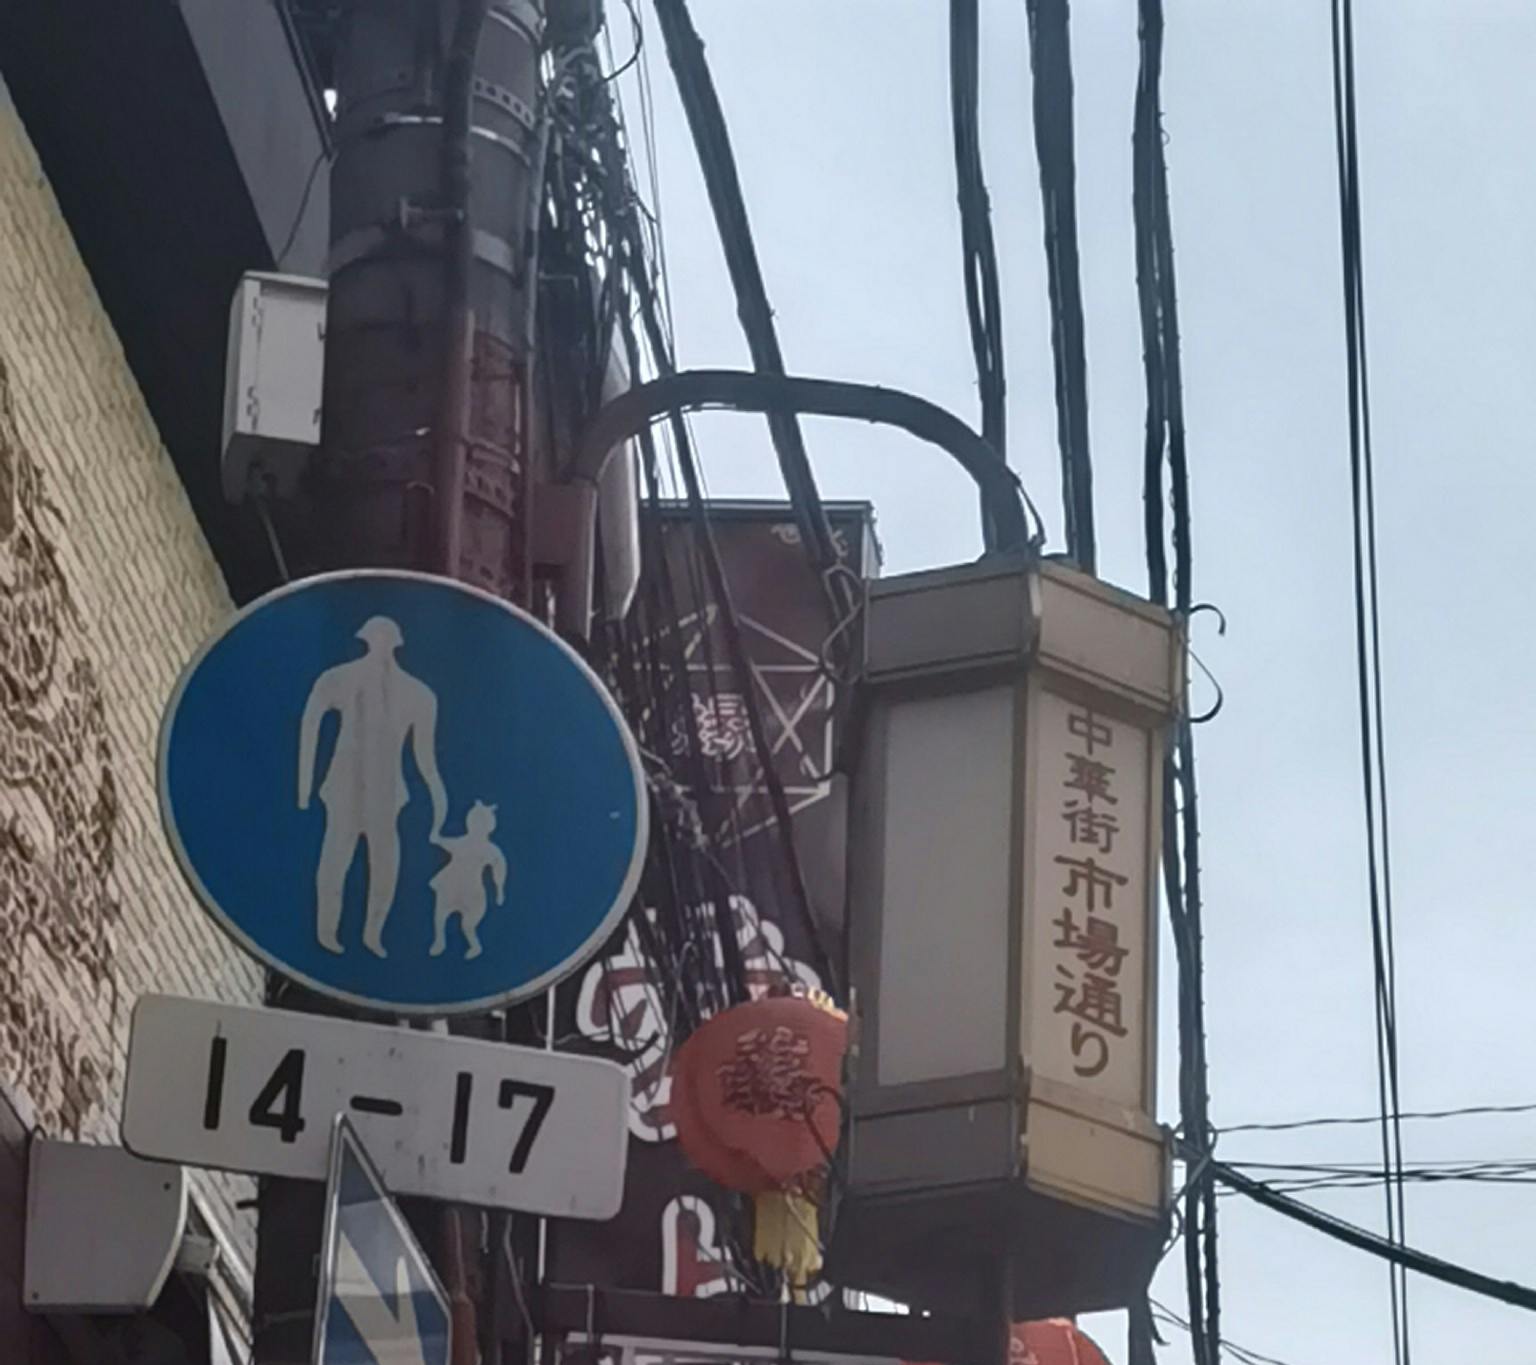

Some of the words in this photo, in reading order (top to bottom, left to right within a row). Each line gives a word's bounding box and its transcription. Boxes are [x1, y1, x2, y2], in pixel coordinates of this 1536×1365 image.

[1053, 705, 1129, 1079] 中華街市場通り
